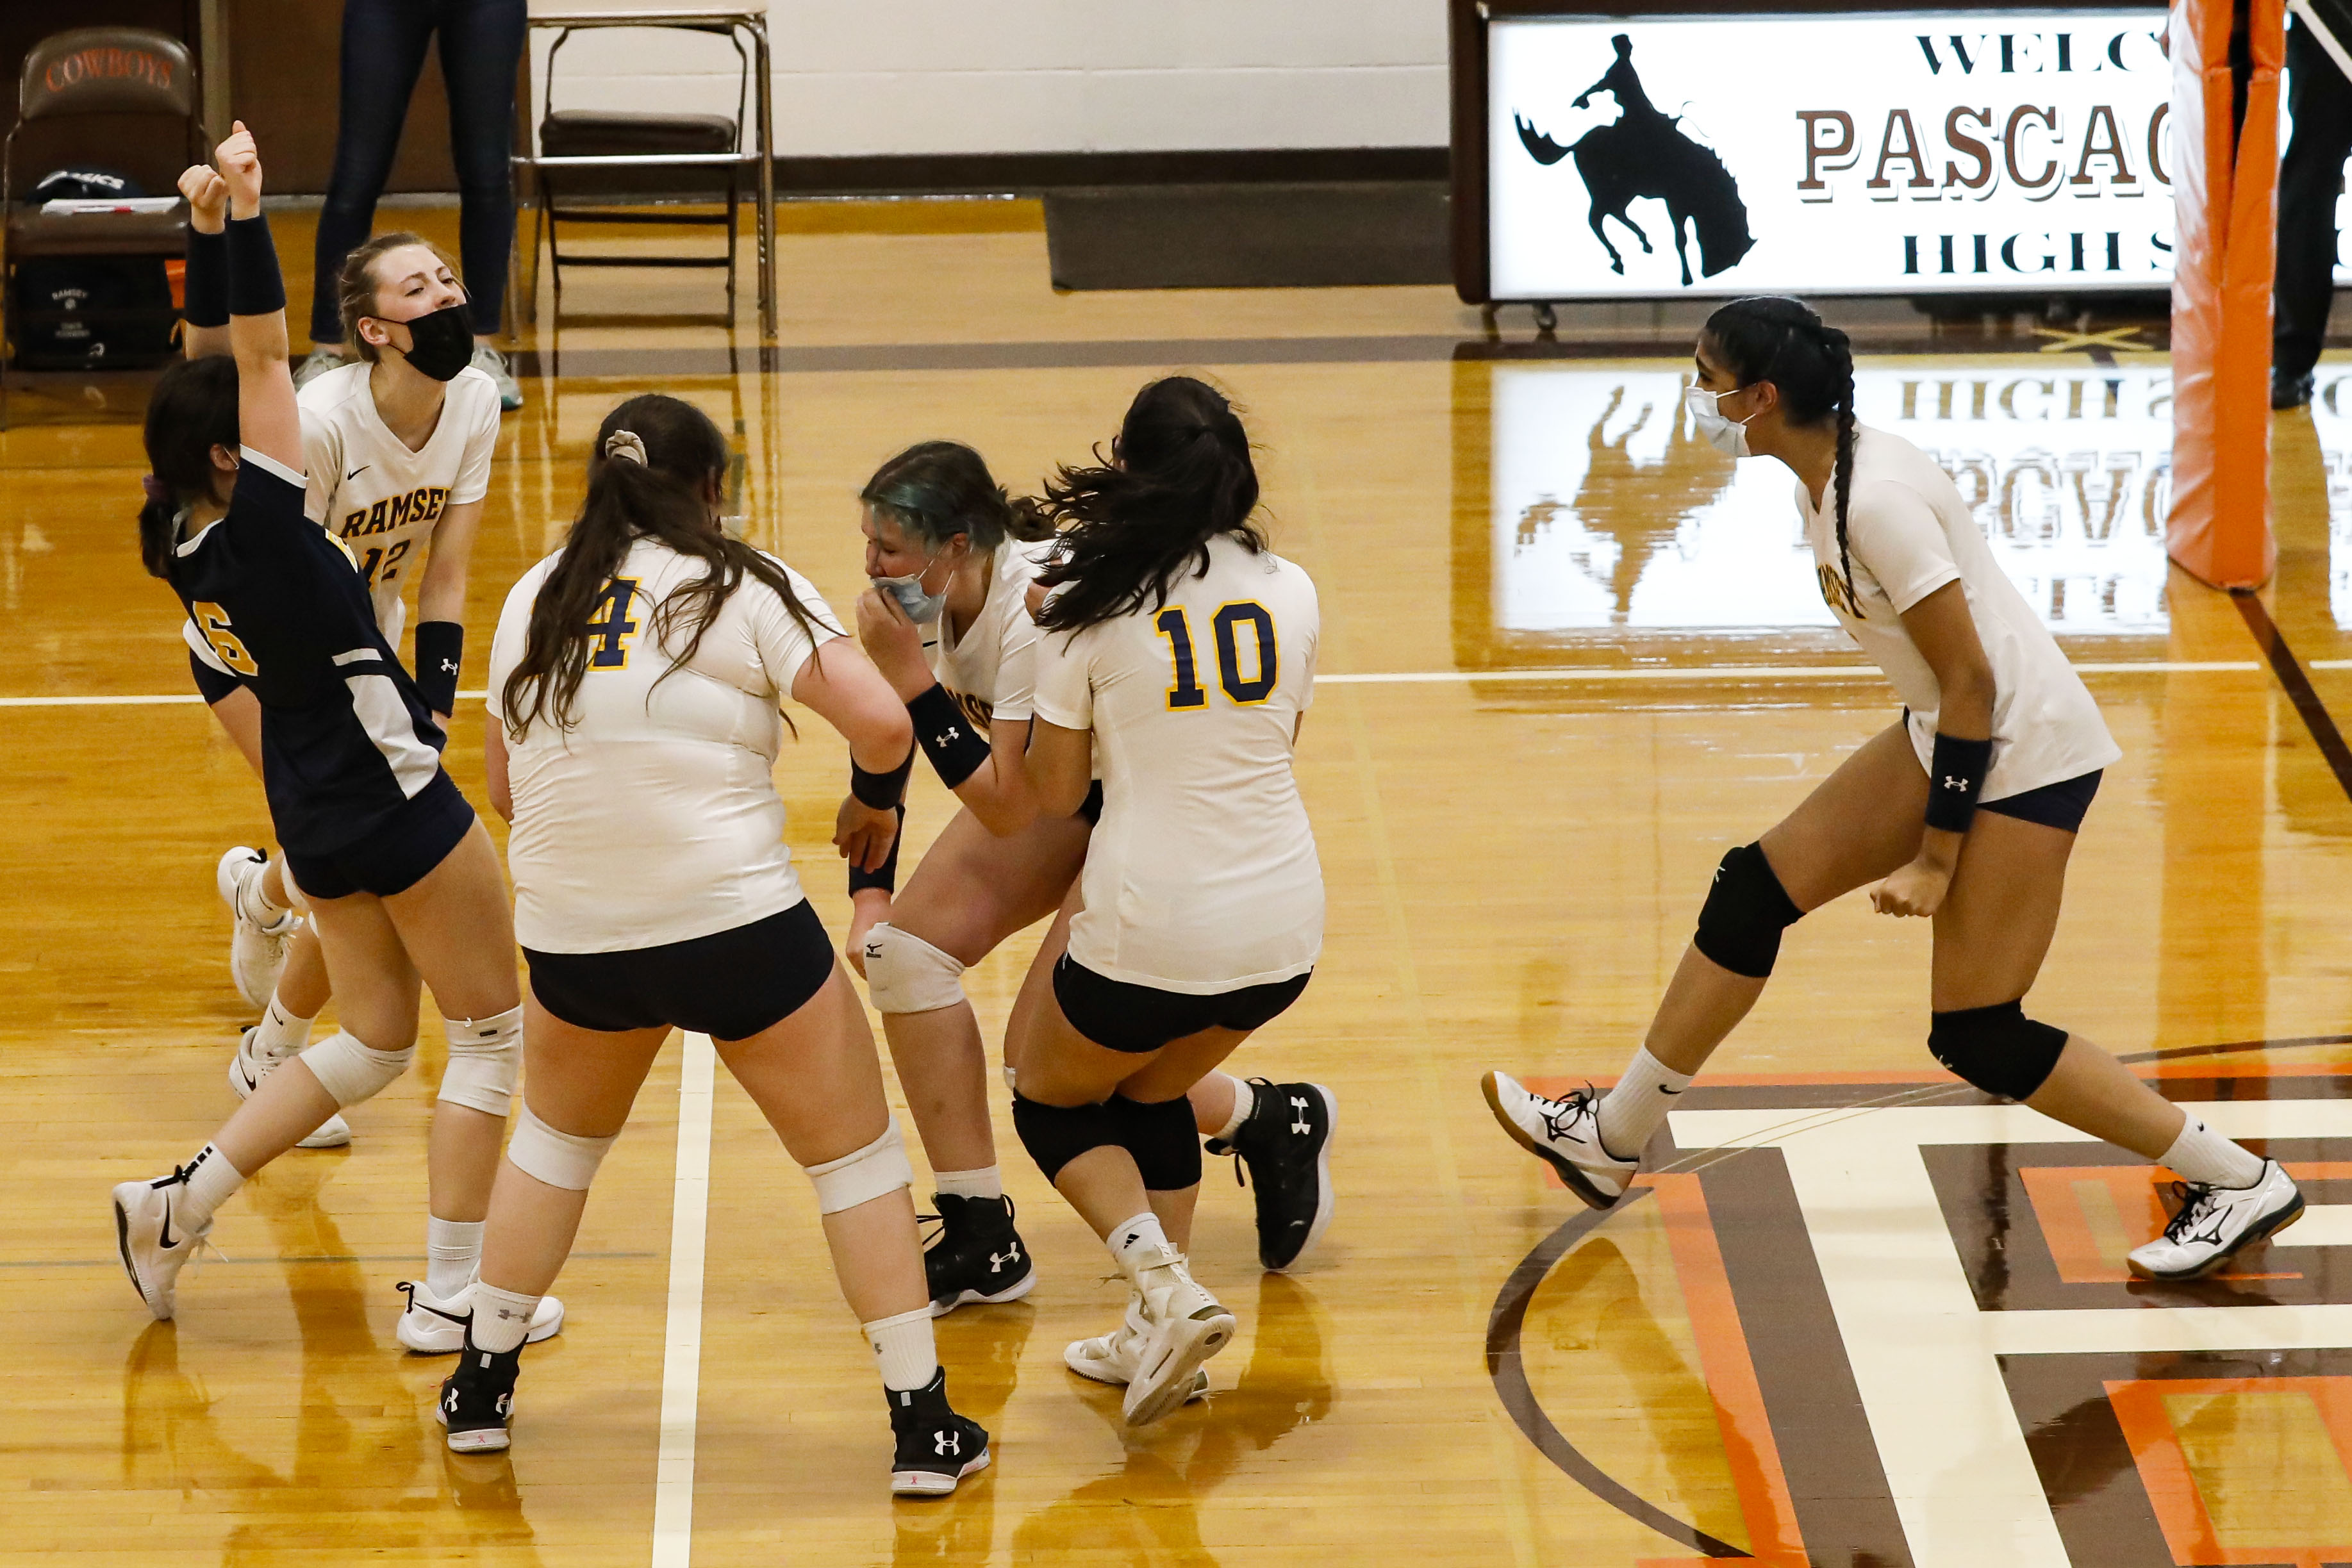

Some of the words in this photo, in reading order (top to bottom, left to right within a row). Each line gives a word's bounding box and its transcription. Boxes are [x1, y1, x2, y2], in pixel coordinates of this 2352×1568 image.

[46, 47, 174, 92] COWBOYS
[1901, 231, 2123, 274] HIGH
[338, 486, 452, 539] RAMSE
[362, 538, 411, 591] 12
[192, 600, 259, 677] 6
[584, 575, 643, 672] 4
[1152, 598, 1281, 712] 10
